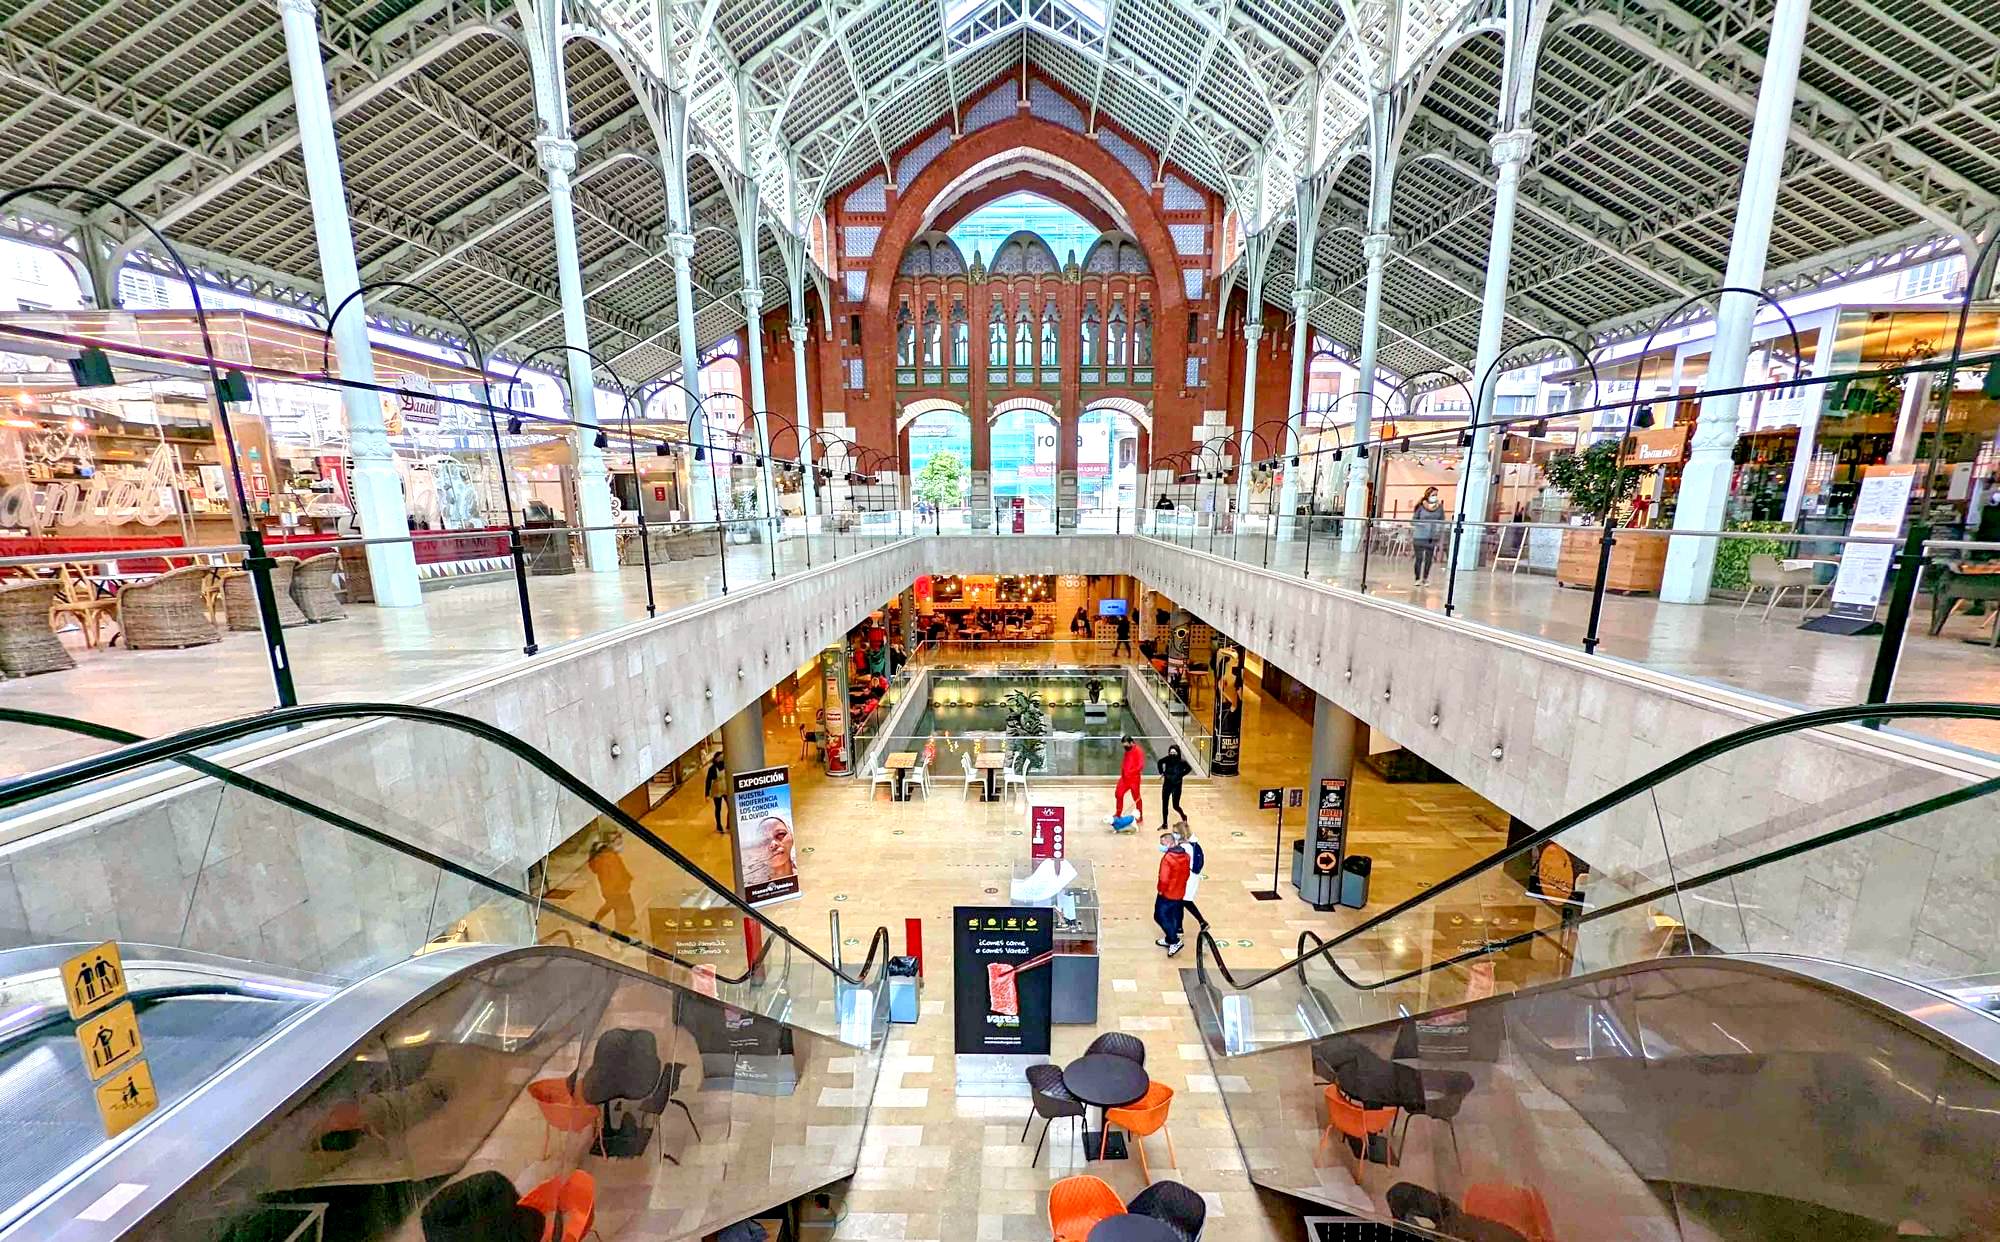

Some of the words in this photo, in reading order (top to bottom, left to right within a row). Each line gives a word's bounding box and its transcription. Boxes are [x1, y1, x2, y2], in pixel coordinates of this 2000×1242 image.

[400, 386, 437, 416] Daniel
[738, 772, 785, 788] EXPOSICIÓN
[738, 790, 765, 800] NUESTRA
[739, 796, 778, 807] INDIFERENCIA
[740, 806, 753, 814] LOS
[752, 801, 779, 812] CONDENA
[749, 810, 769, 819] OLVIDO
[986, 1014, 1020, 1025] varea
